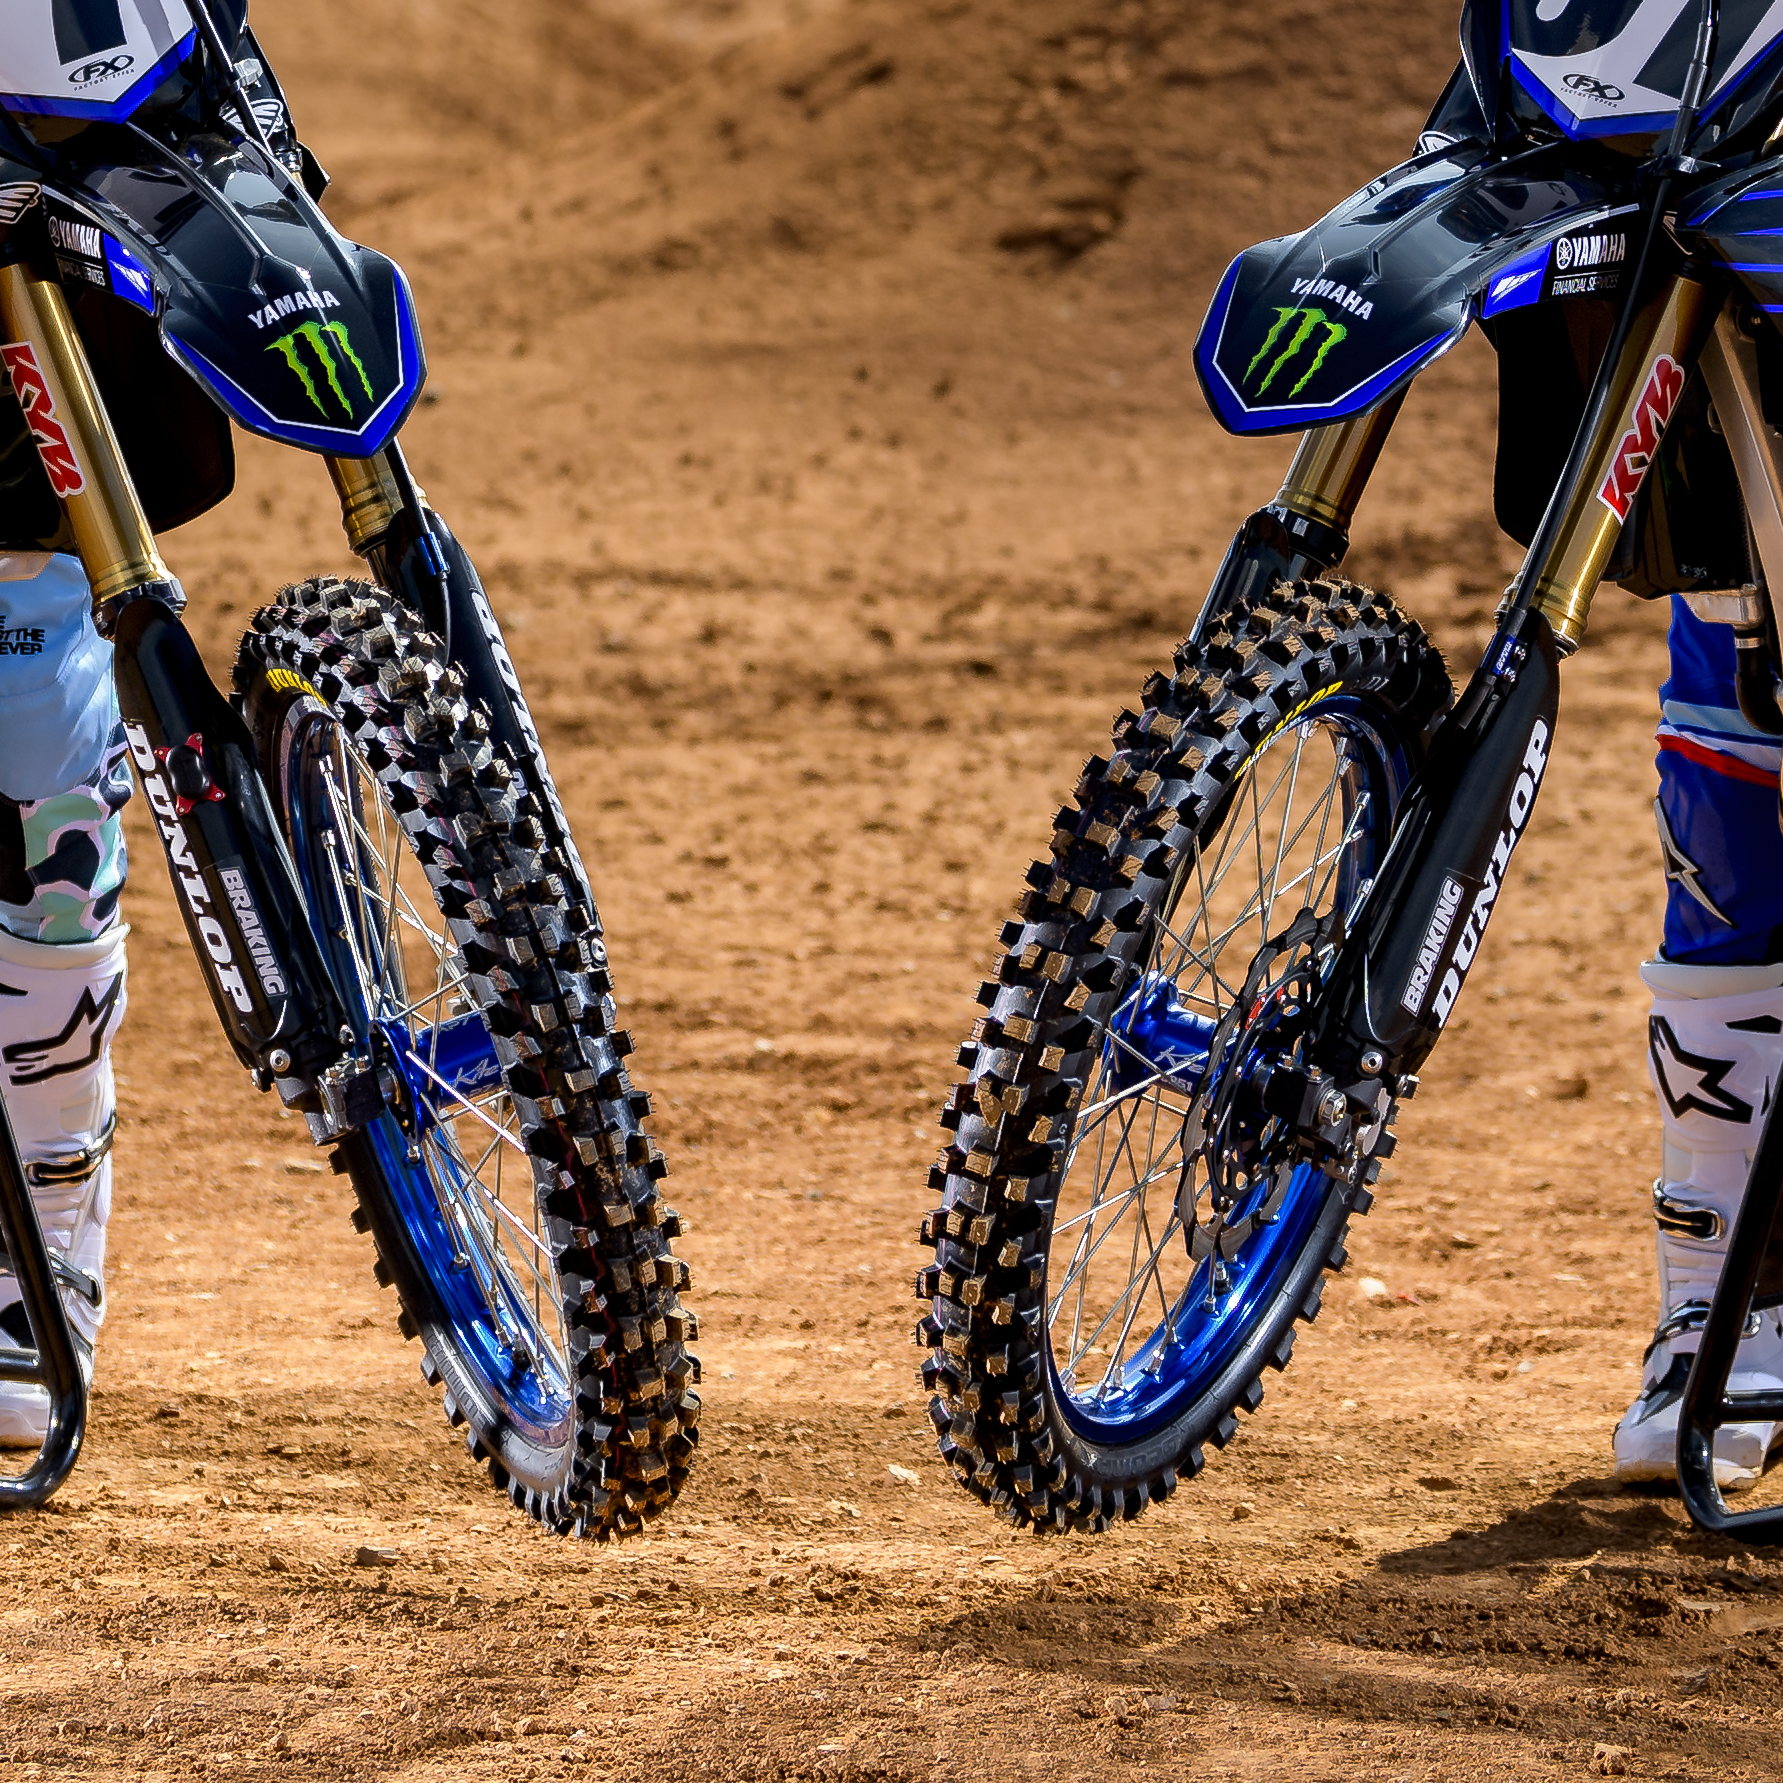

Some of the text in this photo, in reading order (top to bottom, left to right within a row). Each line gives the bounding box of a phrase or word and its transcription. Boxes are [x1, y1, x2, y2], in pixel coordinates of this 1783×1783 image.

[59, 220, 102, 258] YAMAHA
[1572, 233, 1626, 267] YAMAHA
[249, 289, 342, 331] YAMAHA
[1290, 277, 1374, 321] YAMAHA
[14, 628, 46, 643] THE
[122, 721, 253, 1013] DUNLOP
[1431, 719, 1548, 1028] DUNLOP
[219, 869, 288, 997] BRAKING
[1401, 876, 1464, 1017] BRAKING
